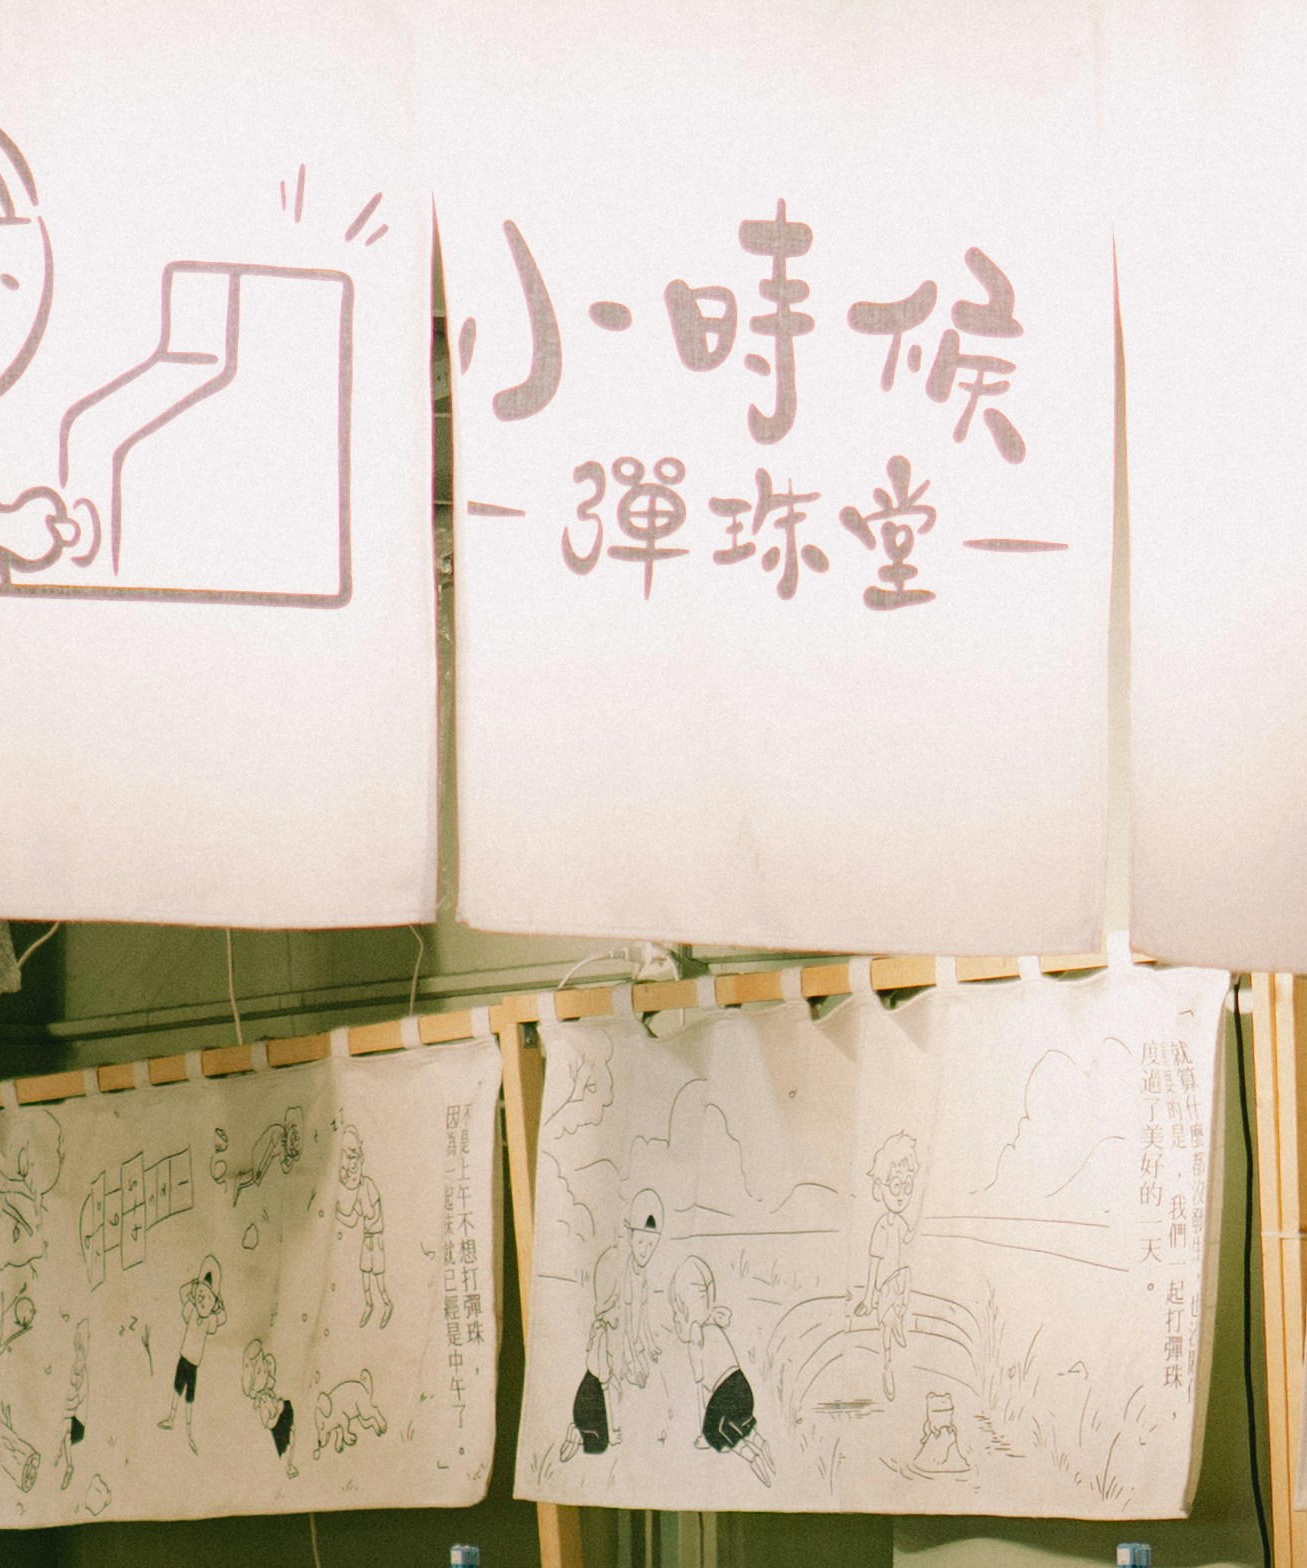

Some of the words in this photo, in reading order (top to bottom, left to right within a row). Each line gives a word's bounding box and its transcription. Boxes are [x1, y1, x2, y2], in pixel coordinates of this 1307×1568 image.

[457, 197, 1026, 465] 小時候
[561, 454, 937, 612] 彈珠堂
